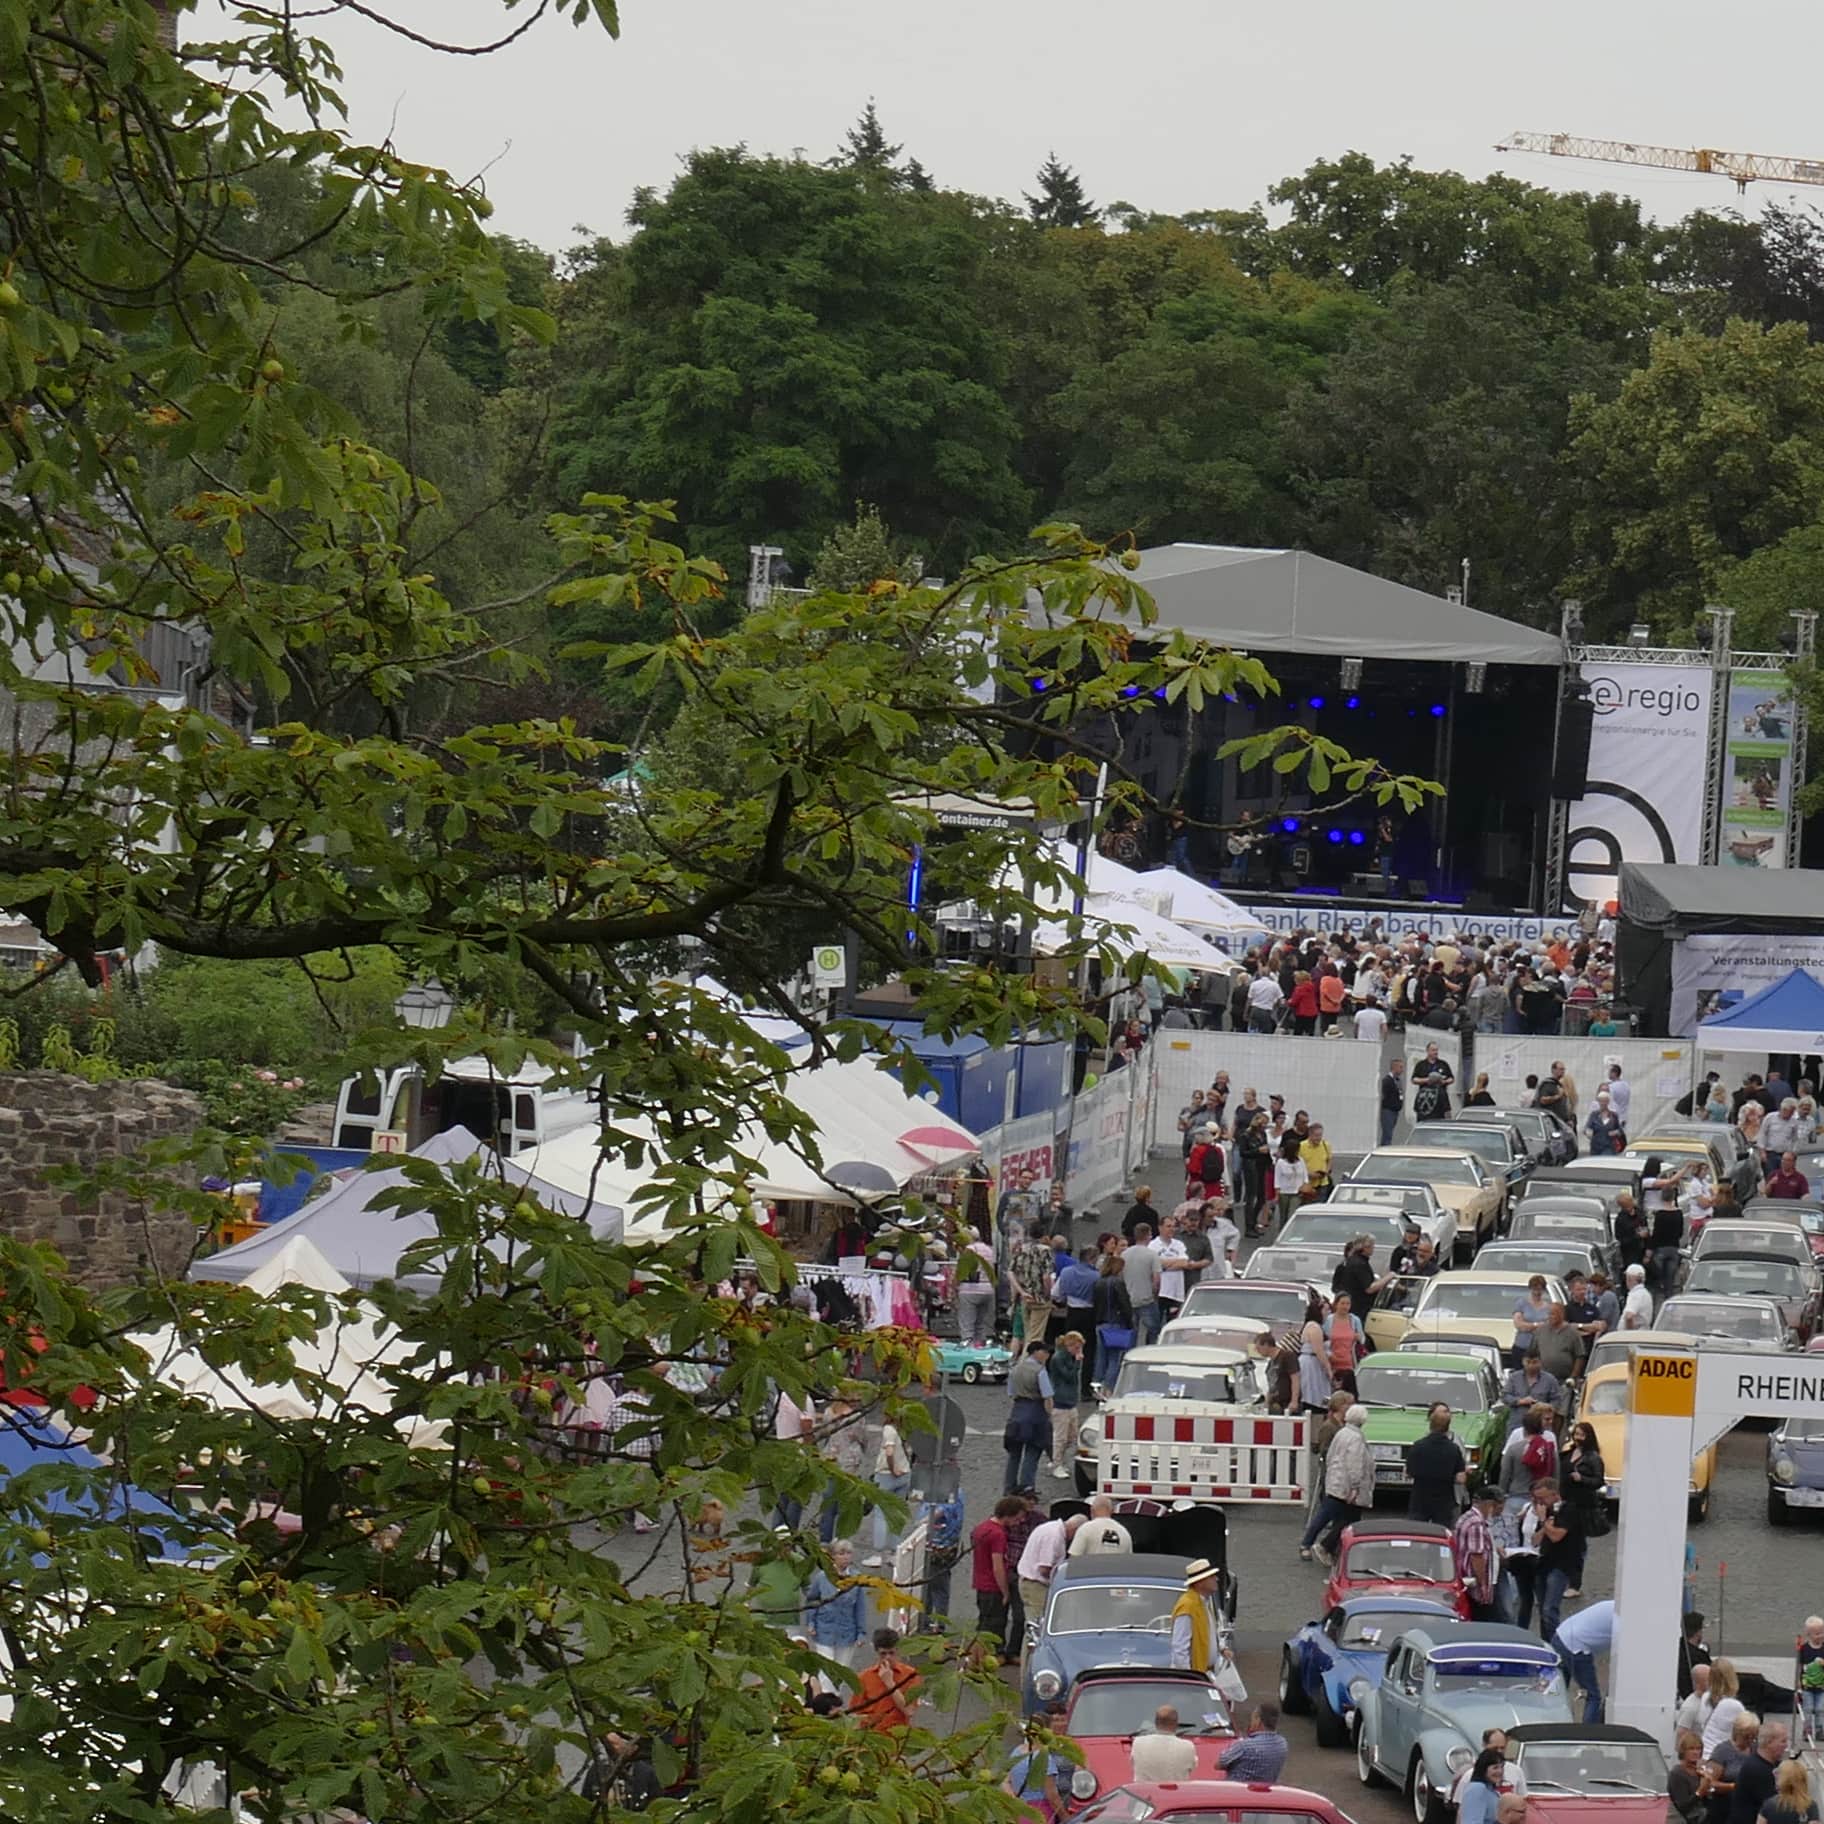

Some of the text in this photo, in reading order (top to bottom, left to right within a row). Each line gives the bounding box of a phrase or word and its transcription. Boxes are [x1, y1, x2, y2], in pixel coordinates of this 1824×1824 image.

[1627, 684, 1700, 716] regio
[1452, 915, 1544, 940] Voreifel
[1639, 1359, 1693, 1379] ADAC
